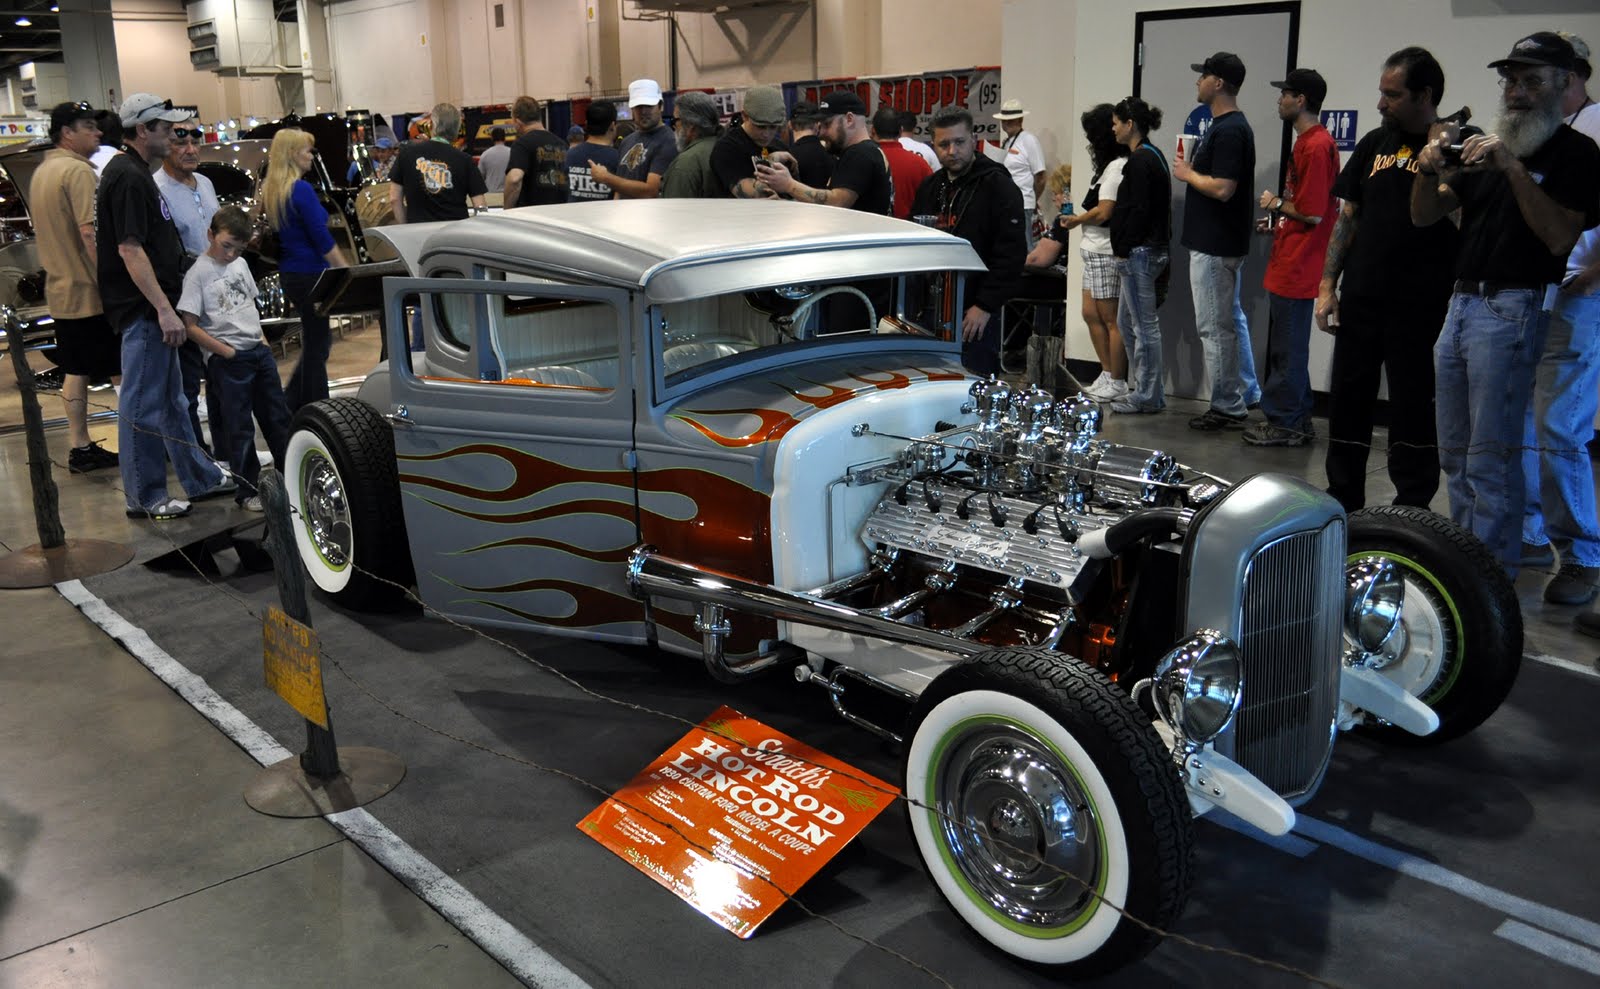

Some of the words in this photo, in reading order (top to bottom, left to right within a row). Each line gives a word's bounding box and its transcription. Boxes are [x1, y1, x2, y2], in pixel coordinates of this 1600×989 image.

[880, 76, 970, 117] SHOPPE
[979, 81, 1001, 112] (95
[8, 124, 33, 134] DOG
[568, 174, 612, 193] FIRE
[1368, 154, 1396, 178] ROAD
[690, 737, 767, 783] HOT
[760, 774, 845, 825] ROD
[740, 738, 833, 789] Stretch's
[659, 766, 682, 780] 1930
[678, 777, 717, 800] CUSTOM
[712, 796, 740, 814] FORD
[736, 810, 772, 832] MODEL
[767, 828, 782, 838] A
[778, 833, 817, 856] COUPE
[668, 752, 836, 846] LINCOLN
